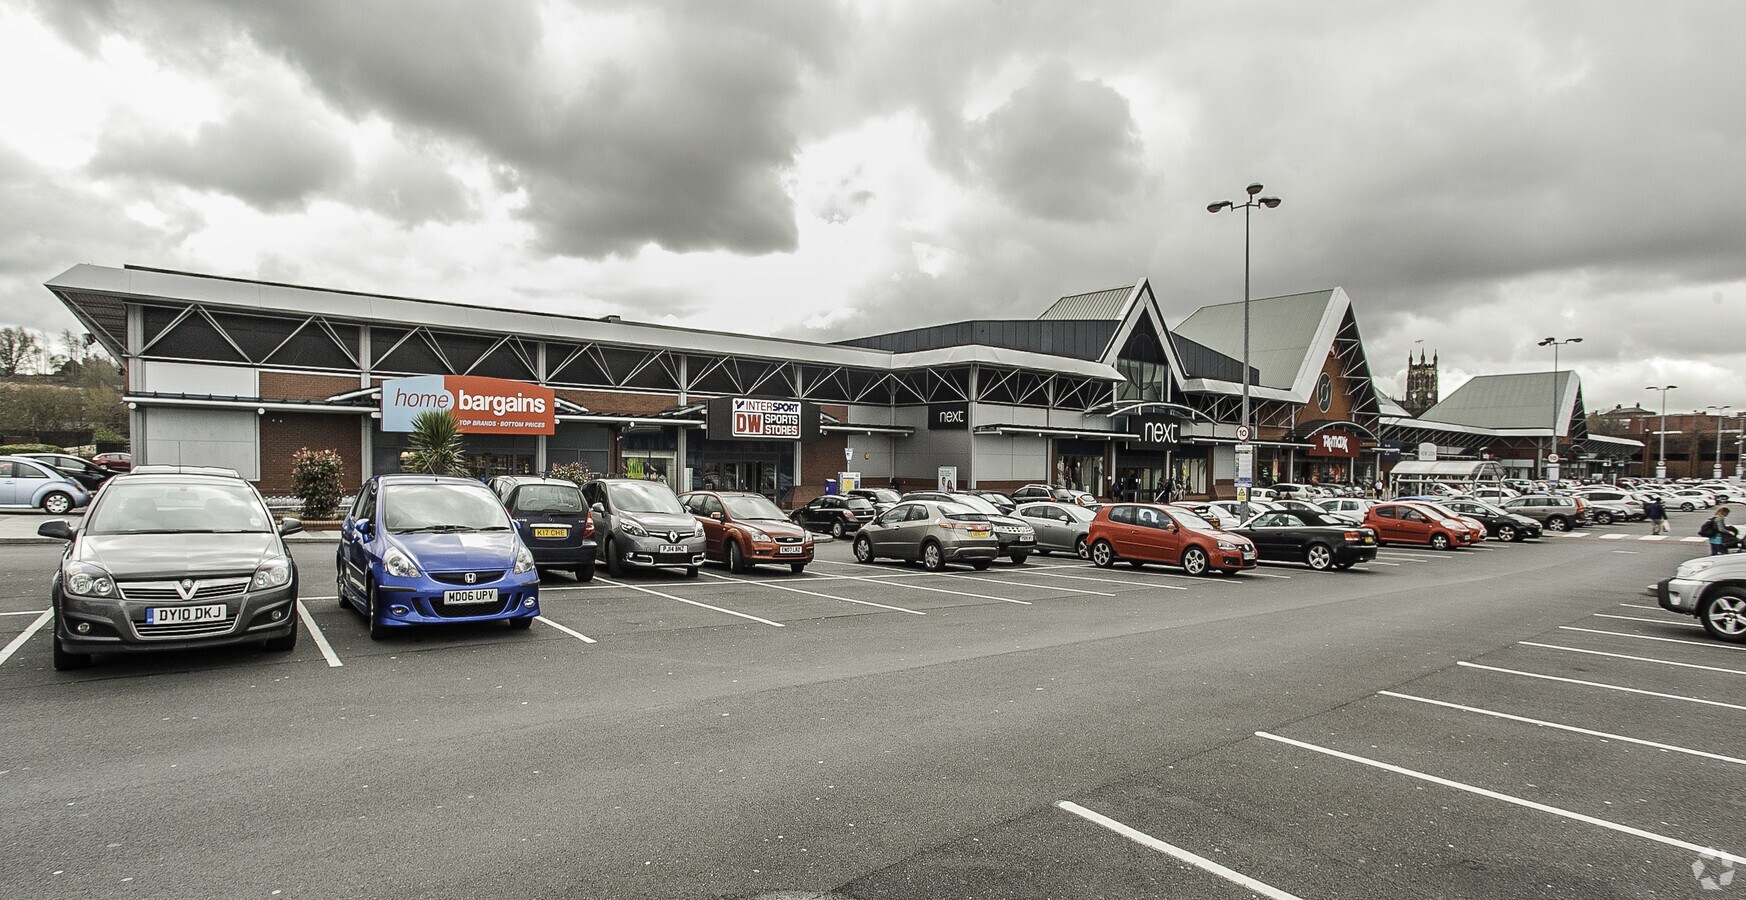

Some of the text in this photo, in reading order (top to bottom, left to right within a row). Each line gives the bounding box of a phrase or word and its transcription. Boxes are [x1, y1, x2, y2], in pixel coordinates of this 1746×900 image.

[395, 388, 546, 417] home bargains
[746, 401, 799, 412] INTERSPORT
[765, 414, 798, 425] SPORTS
[940, 411, 964, 422] next
[736, 413, 761, 433] DW
[765, 425, 798, 435] STORES
[1144, 421, 1178, 443] next
[1238, 429, 1247, 437] 10
[449, 589, 494, 602] MD06 UPV
[159, 606, 221, 621] DY10 DKJ
